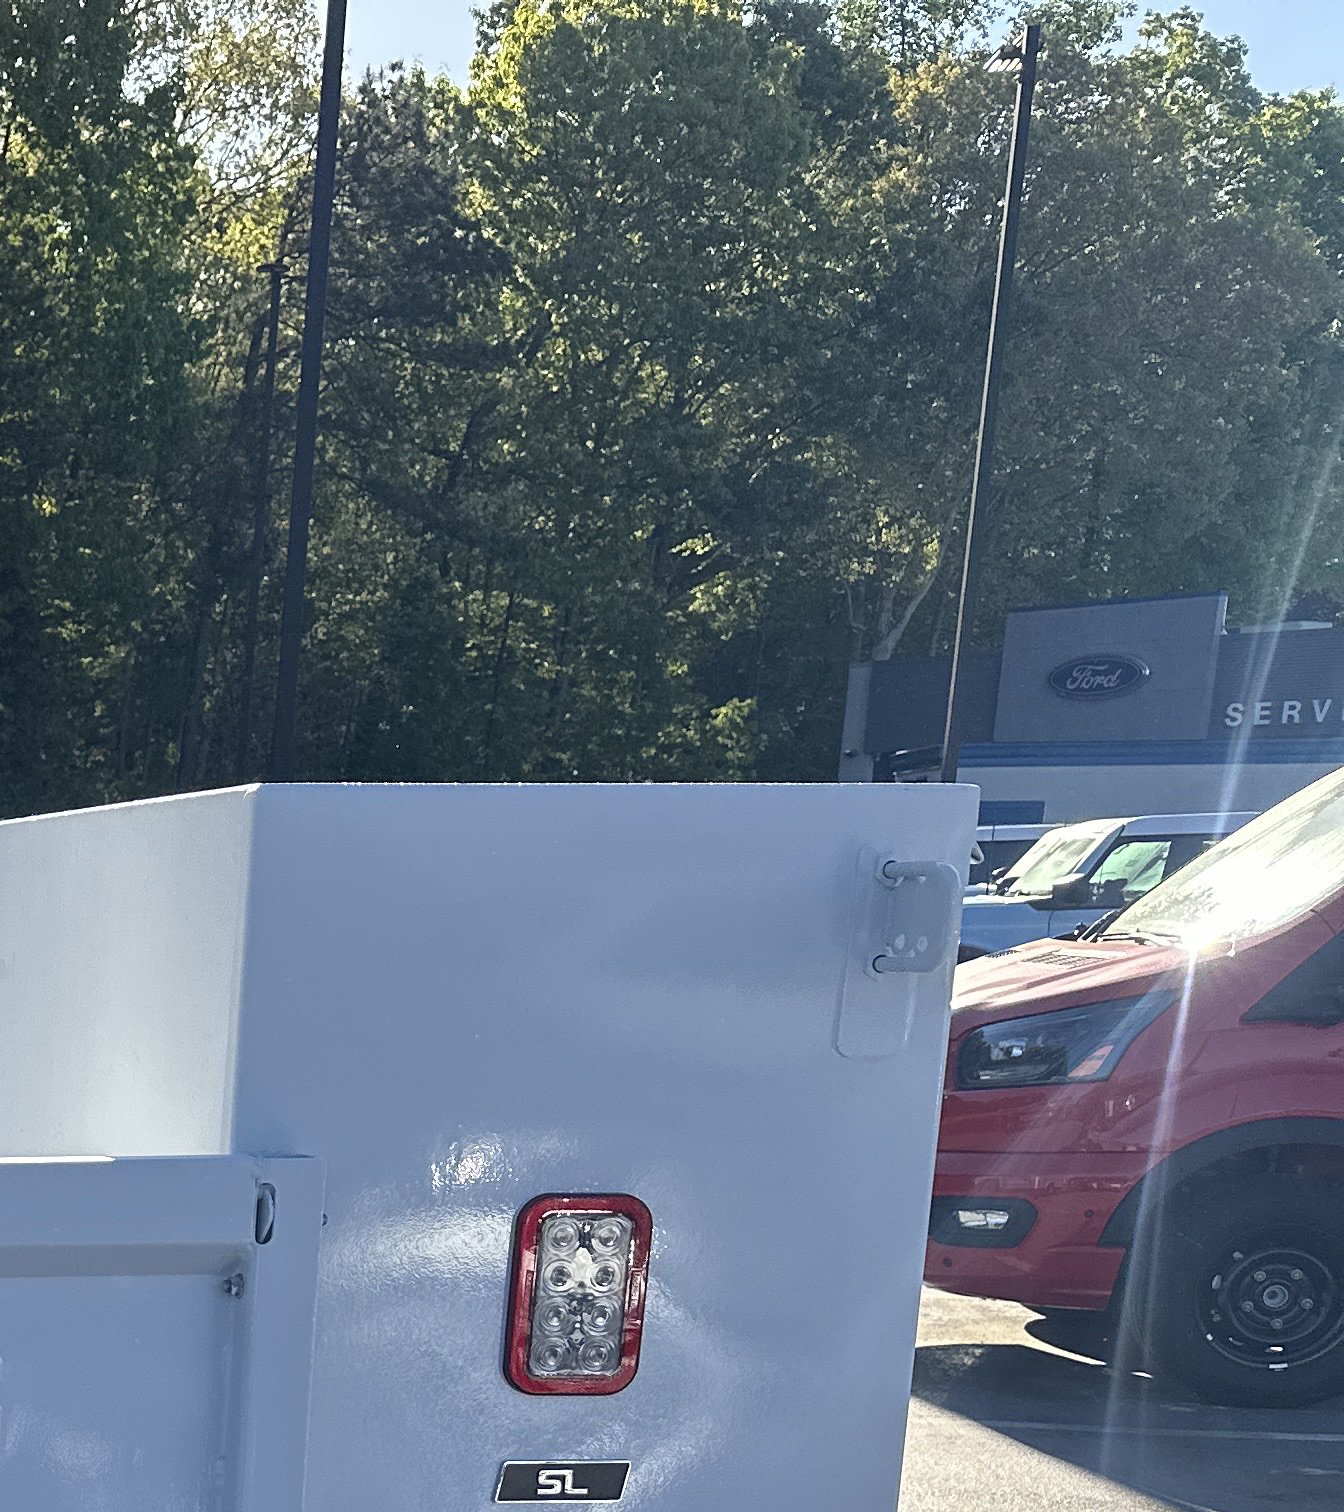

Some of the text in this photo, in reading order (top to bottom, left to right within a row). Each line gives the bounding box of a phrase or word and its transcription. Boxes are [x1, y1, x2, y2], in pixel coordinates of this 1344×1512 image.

[1067, 663, 1123, 690] Ford
[1224, 698, 1344, 728] SERV
[536, 1469, 589, 1495] SL
